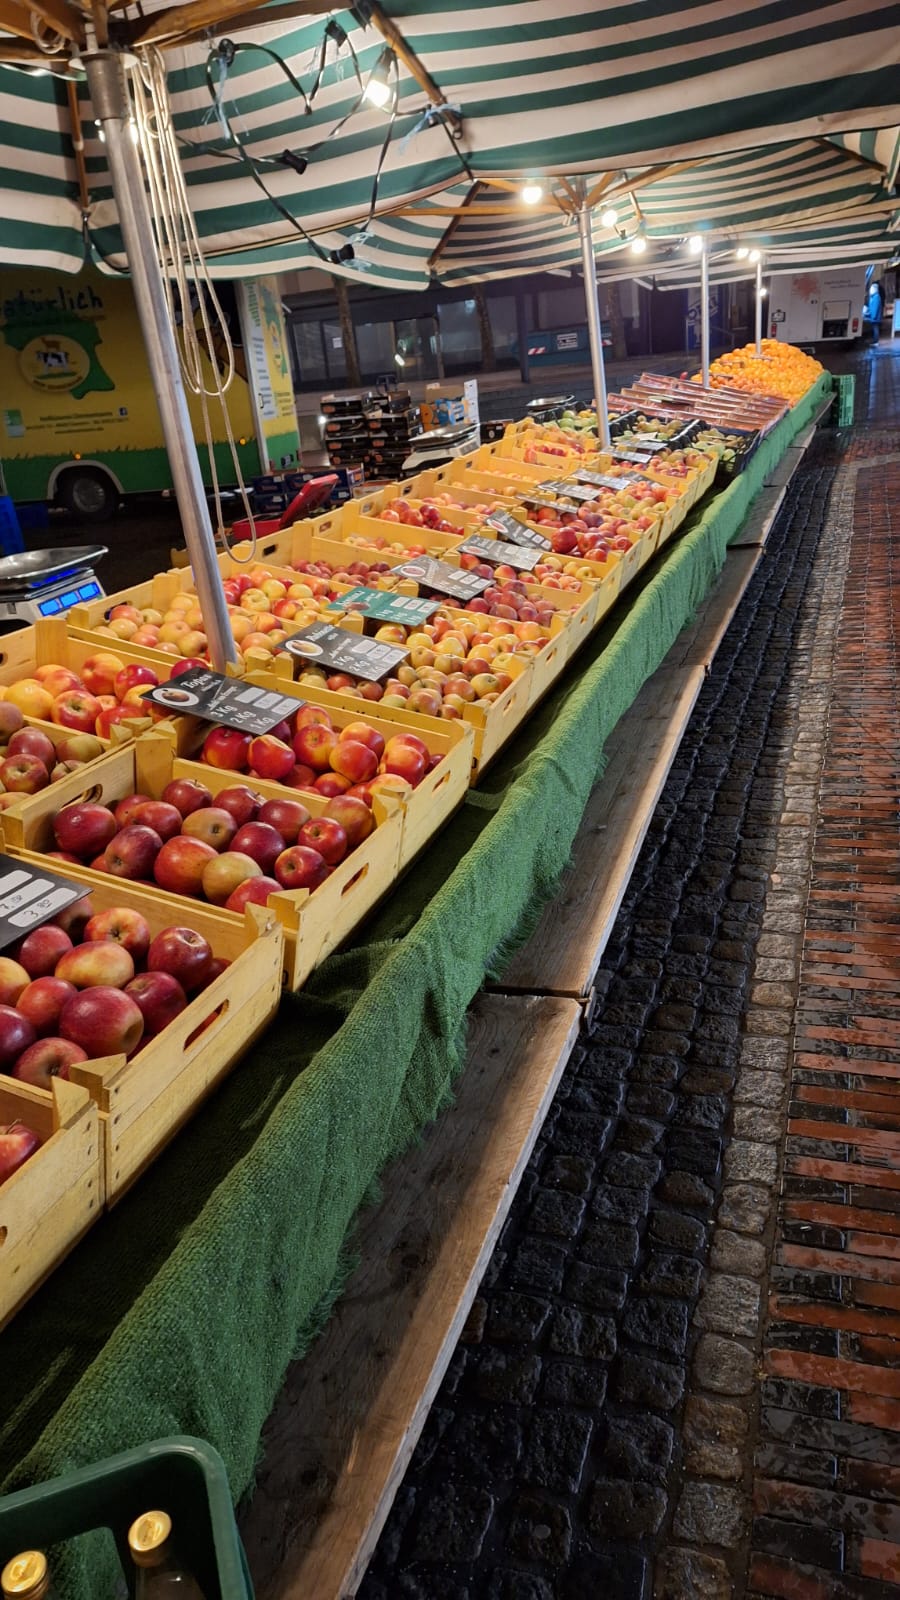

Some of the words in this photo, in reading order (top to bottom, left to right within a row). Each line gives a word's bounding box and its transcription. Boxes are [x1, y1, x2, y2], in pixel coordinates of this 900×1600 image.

[0, 285, 104, 318] atürlich
[216, 704, 238, 716] Kg
[235, 710, 256, 720] Kg
[230, 716, 243, 724] 2
[254, 716, 275, 726] Kg
